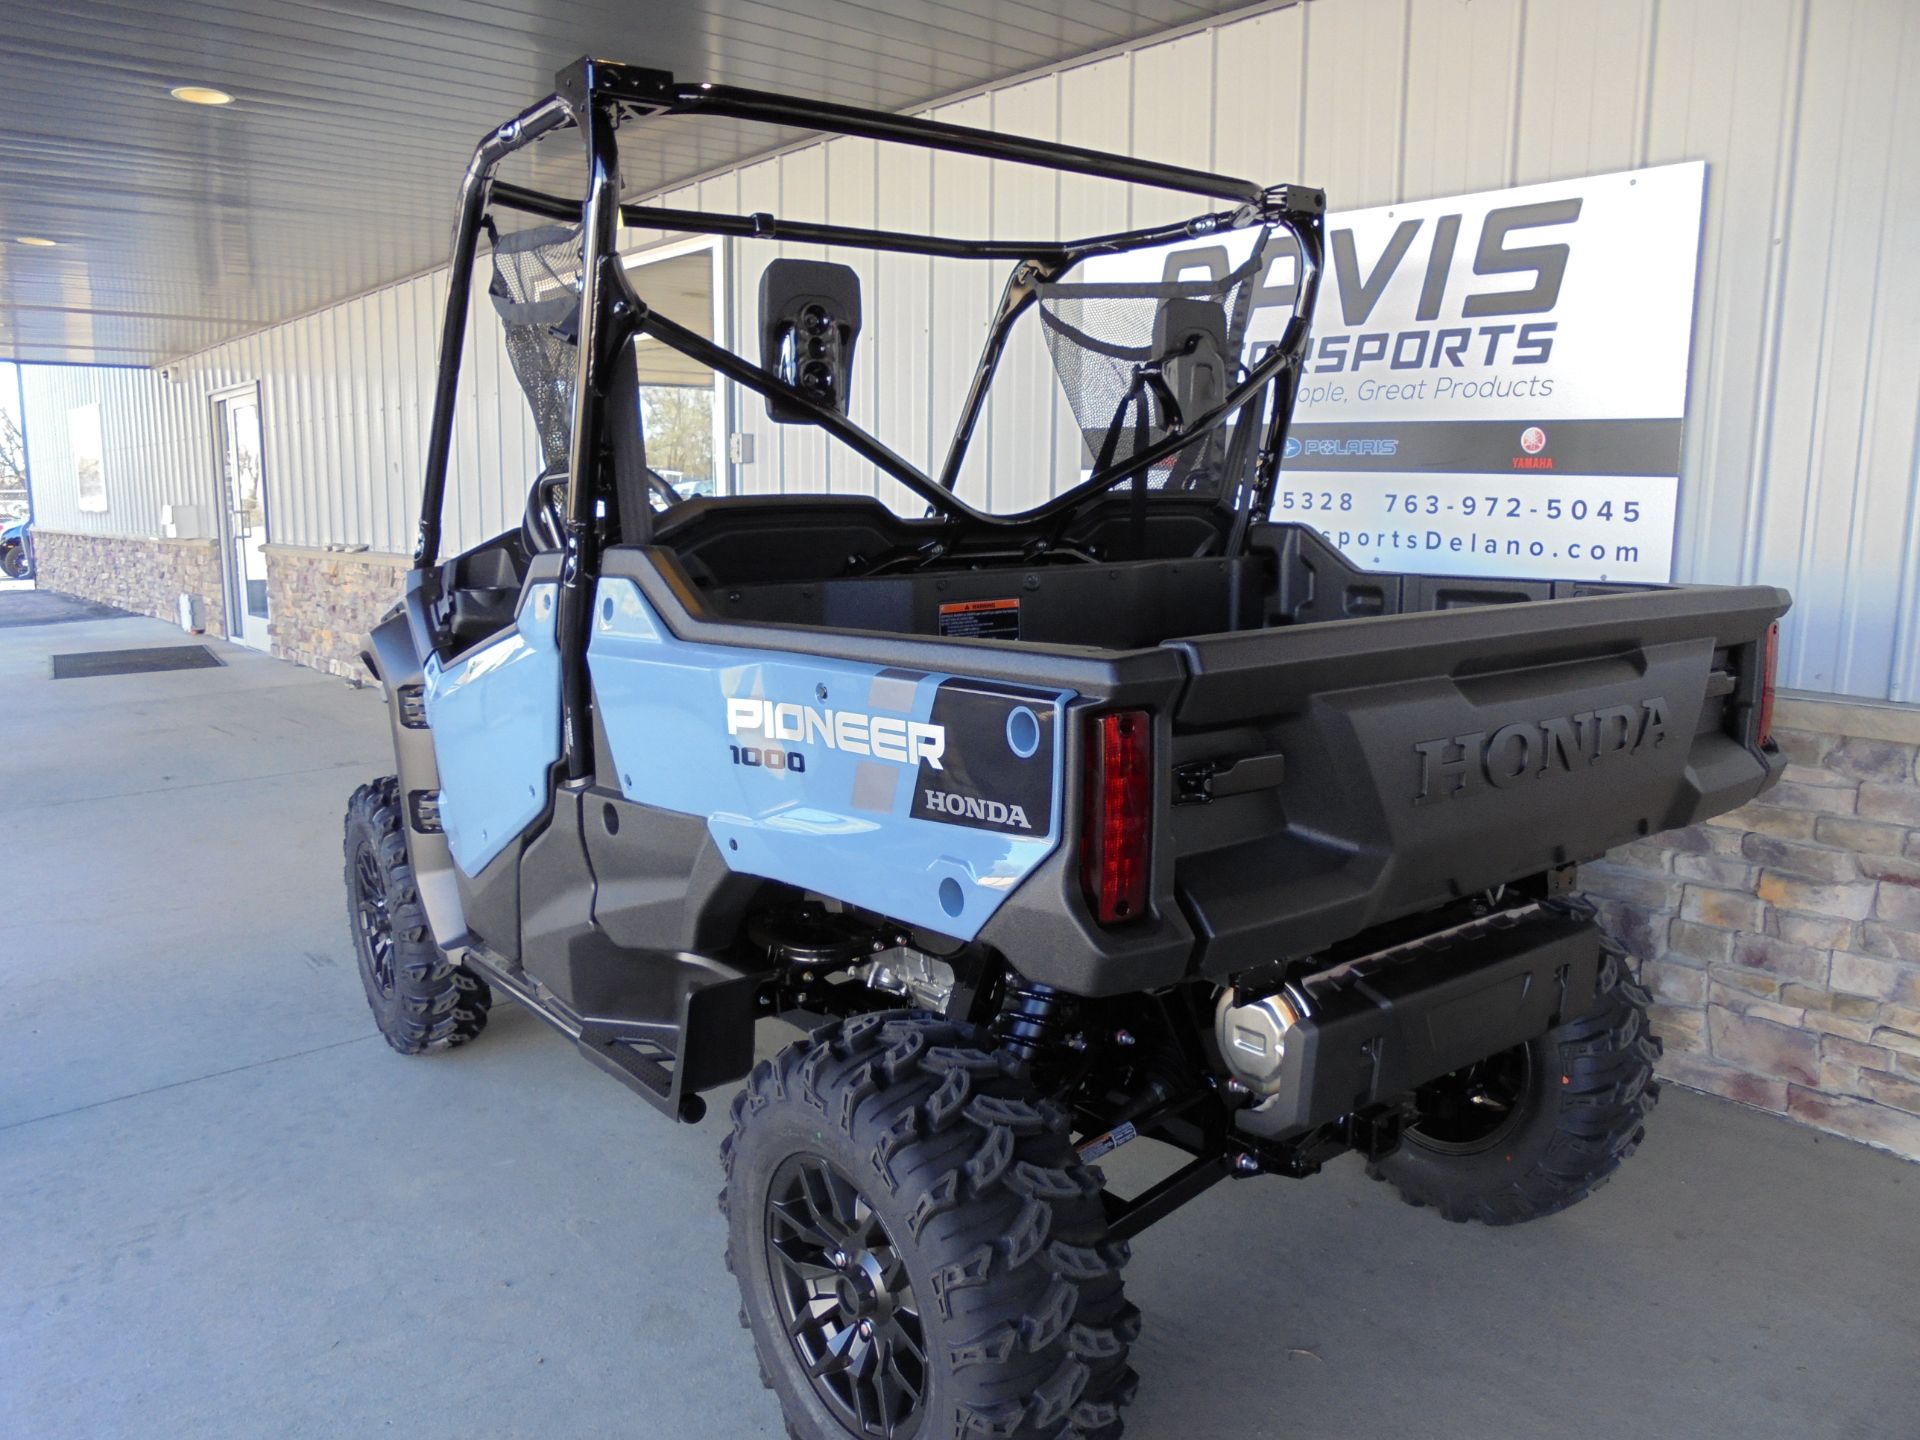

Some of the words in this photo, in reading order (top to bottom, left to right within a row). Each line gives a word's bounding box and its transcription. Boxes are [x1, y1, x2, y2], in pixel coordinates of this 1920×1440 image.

[1357, 377, 1425, 401] Great
[1434, 375, 1553, 400] Products
[1304, 439, 1396, 456] POLARIS
[1512, 457, 1553, 469] YAMAHA
[1272, 491, 1353, 511] 5328
[1384, 493, 1640, 523] 763-972-5045
[726, 697, 945, 770] PIONEER
[730, 745, 806, 773] 1000
[1414, 696, 1671, 805] HONDA
[925, 789, 1031, 829] HONDA
